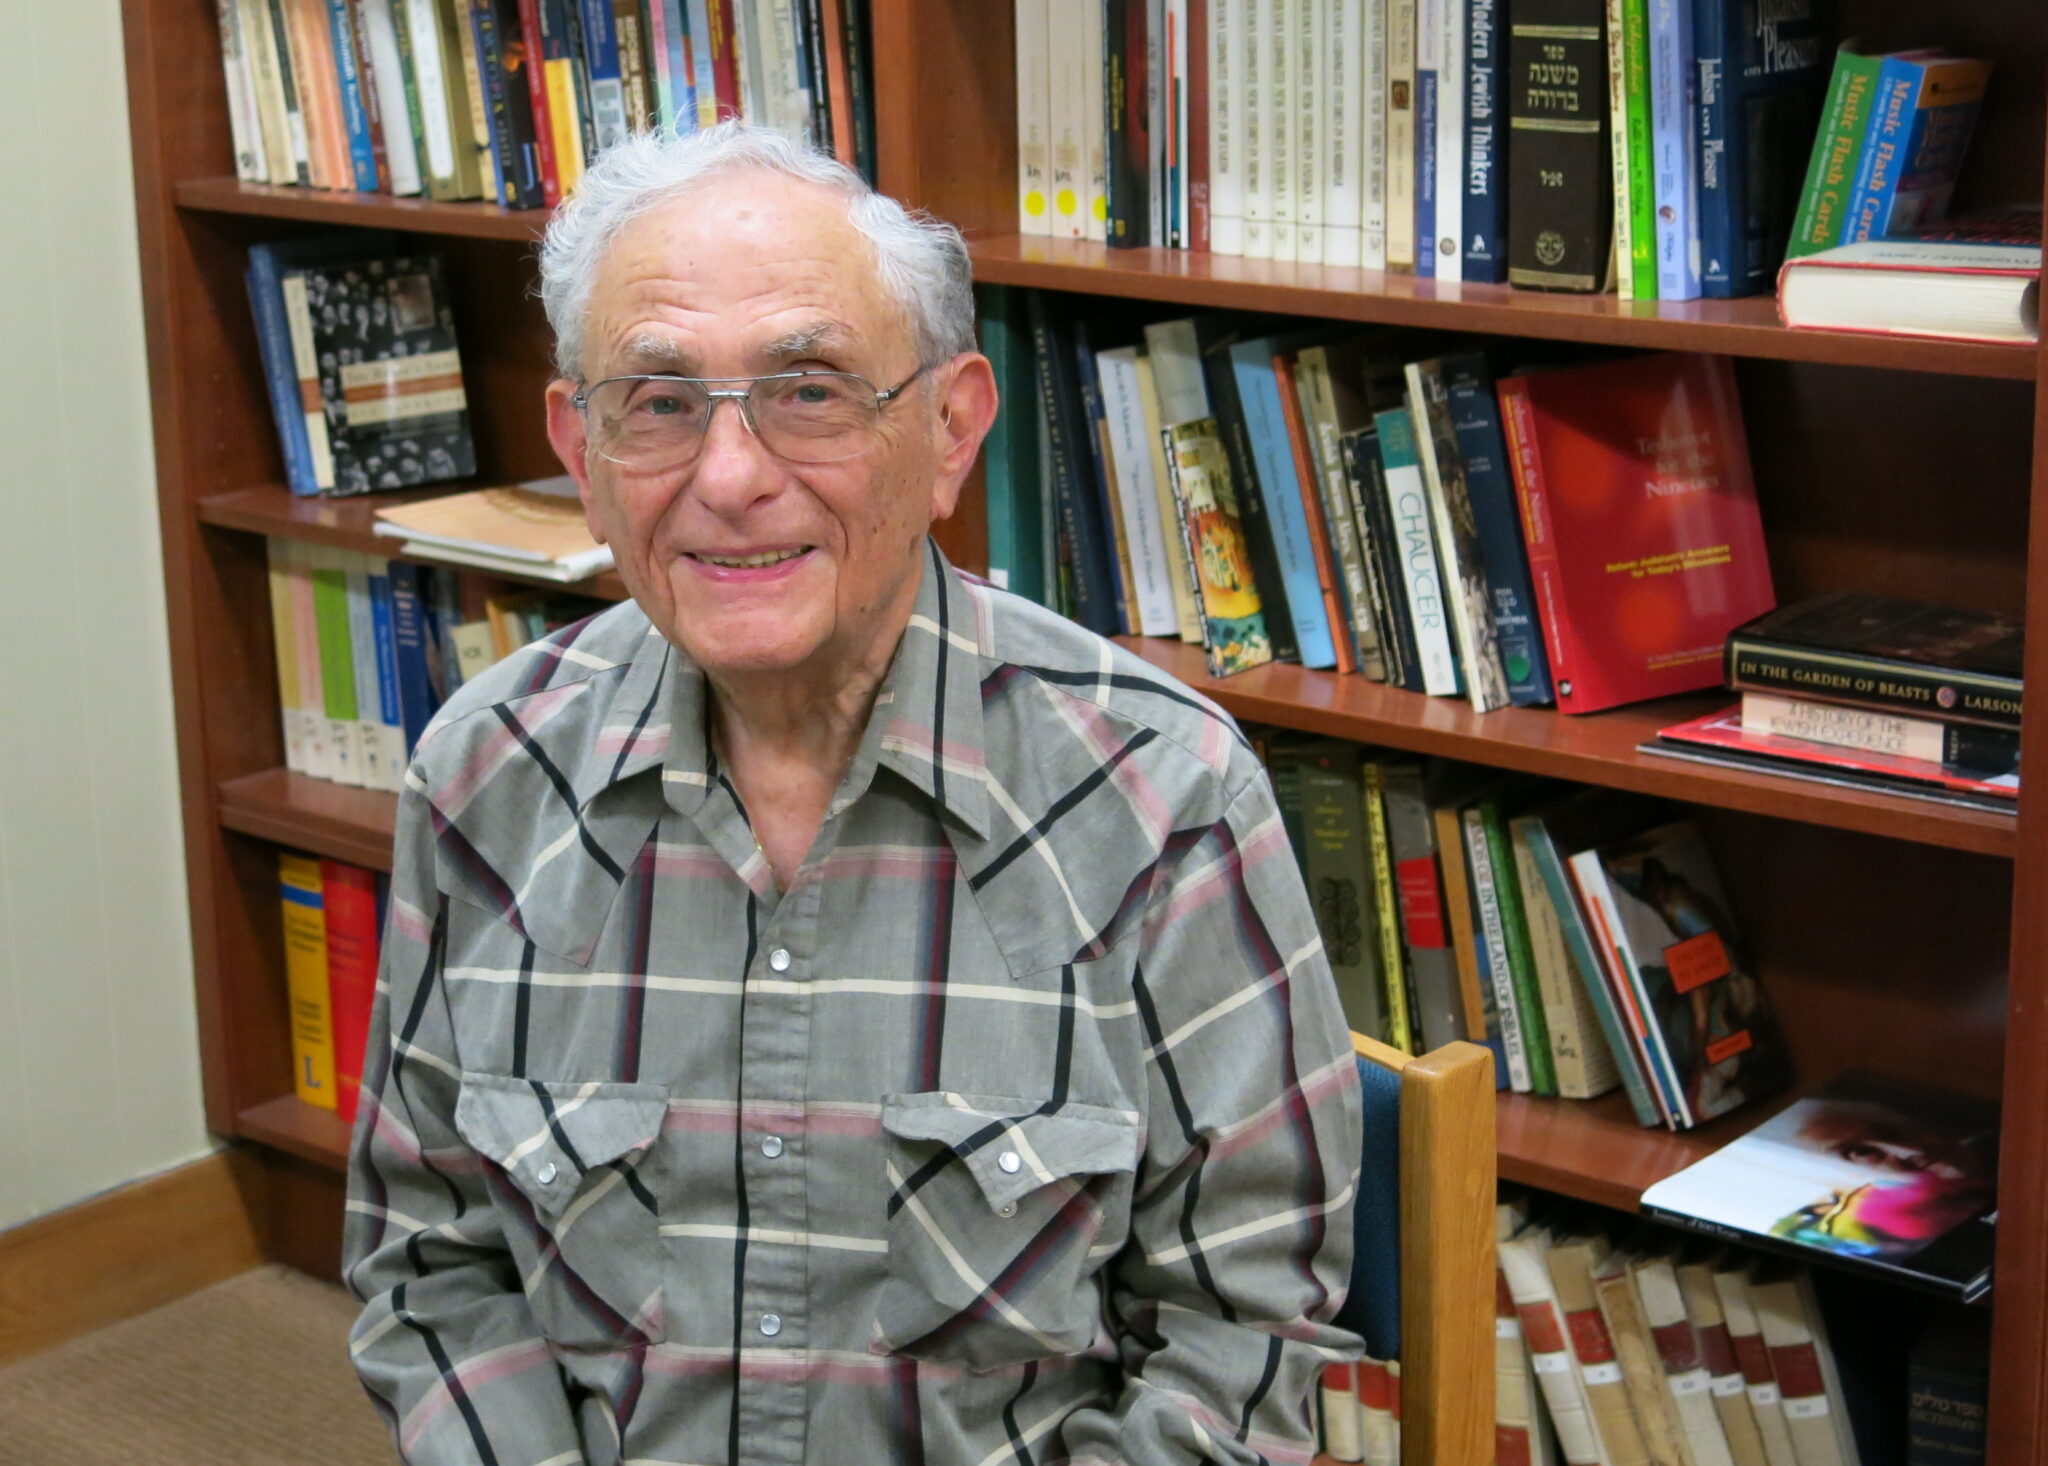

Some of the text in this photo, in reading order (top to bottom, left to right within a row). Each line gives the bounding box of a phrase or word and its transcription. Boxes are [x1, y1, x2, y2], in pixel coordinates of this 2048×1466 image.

[1529, 62, 1579, 86] משנה
[1469, 0, 1493, 196] Modern Jewish Thinkers
[1527, 88, 1579, 112] ברורה
[1703, 107, 1711, 135] on
[1812, 74, 1869, 245] Music Flash Cards
[1856, 79, 1912, 243] Music Flash Card
[1400, 491, 1440, 630] CHAUCER
[1741, 661, 2023, 714] IN THE GARDEN OF BEASTS LARSON
[1798, 705, 1854, 724] HISTORY
[1855, 714, 1877, 728] OF
[1881, 718, 1907, 735] THE
[1481, 888, 1493, 905] IN
[1483, 907, 1498, 938] THE
[1490, 940, 1507, 984] LAND
[1497, 985, 1510, 1004] OF
[1501, 1006, 1520, 1058] ISRAEL
